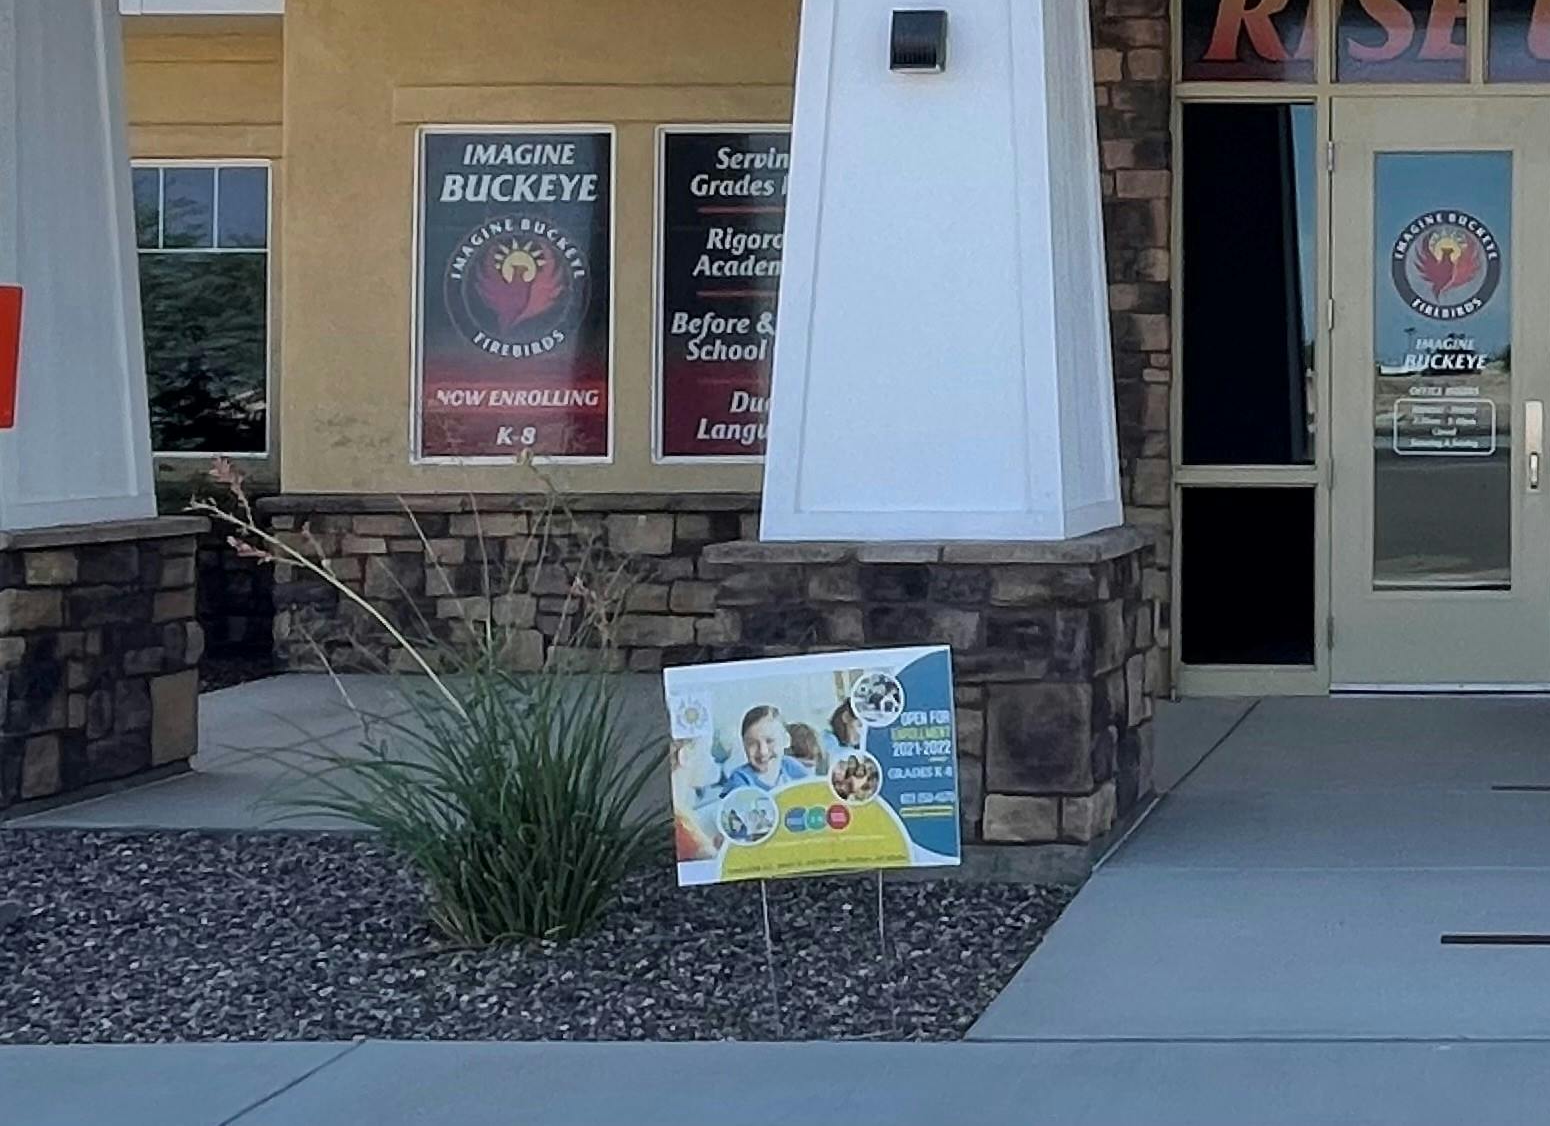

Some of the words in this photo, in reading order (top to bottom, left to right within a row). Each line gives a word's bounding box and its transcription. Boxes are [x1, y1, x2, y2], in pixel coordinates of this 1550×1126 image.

[463, 143, 575, 165] IMAGINE
[715, 146, 789, 170] Servin
[440, 173, 598, 202] BUCKEYE
[690, 174, 775, 196] Grades
[1394, 213, 1442, 260] IMAGINE
[1448, 213, 1498, 260] BUCKEYE
[451, 218, 514, 279] IMAGINE
[520, 218, 585, 278] BUCKEYE
[1411, 298, 1482, 319] FIREBIRDS
[671, 312, 751, 341] Before
[756, 311, 775, 334] &
[472, 329, 566, 358] FIREBIRDS
[686, 338, 768, 361] School
[1416, 338, 1475, 350] IMAGINE
[1404, 353, 1487, 370] BUCKEYE
[436, 389, 486, 407] NOW
[488, 389, 599, 407] ENROLLING
[496, 426, 537, 445] K-8
[697, 417, 768, 445] Langu
[901, 710, 928, 726] OPEN
[892, 739, 952, 757] 2021-2022
[887, 765, 933, 779] GRADES
